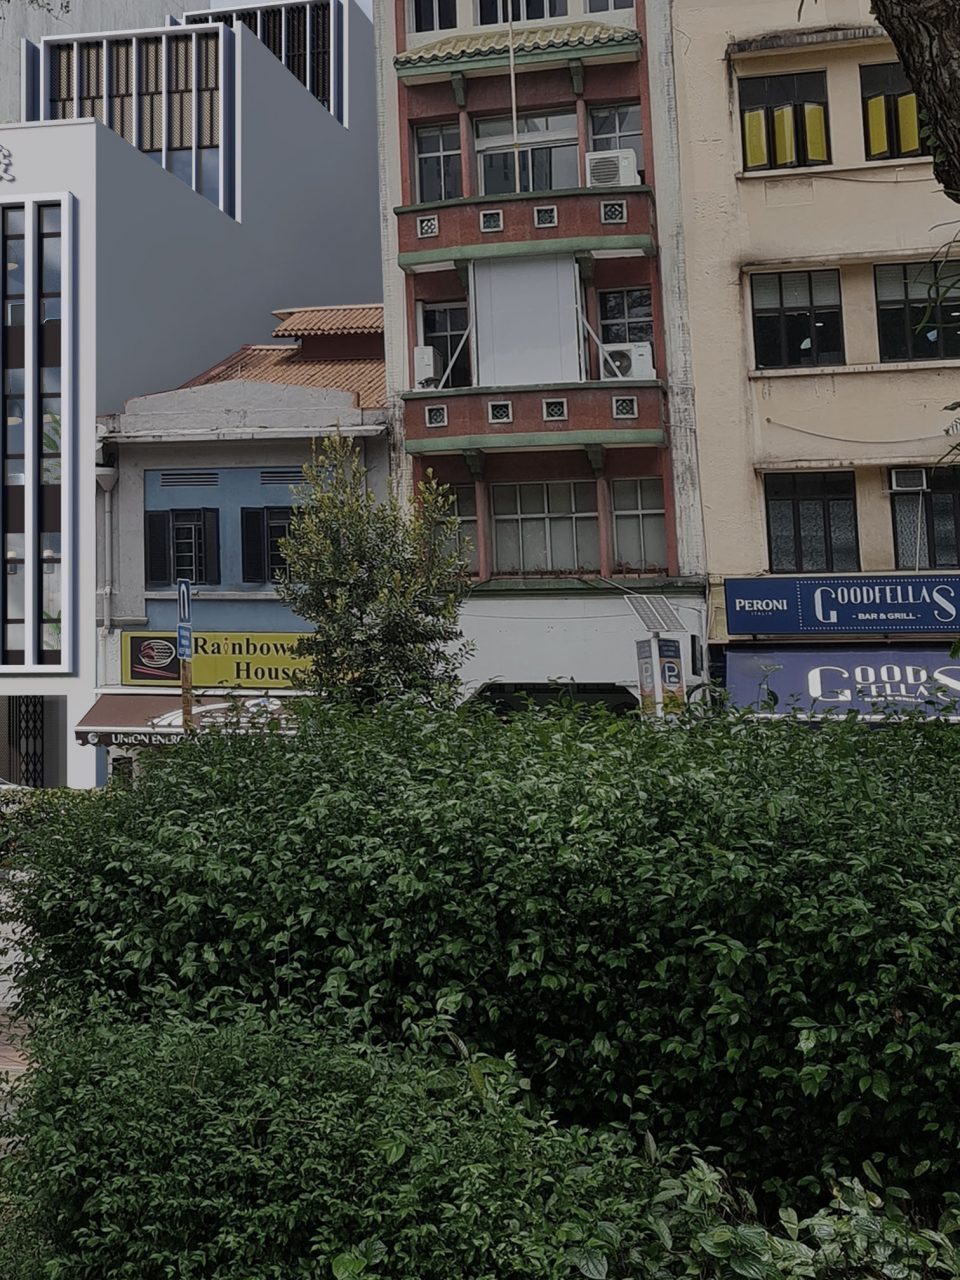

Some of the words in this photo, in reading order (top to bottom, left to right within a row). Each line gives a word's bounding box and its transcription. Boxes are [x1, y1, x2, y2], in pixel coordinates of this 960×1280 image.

[735, 598, 788, 611] PERONI
[814, 585, 957, 624] GOODFELLAS
[857, 612, 878, 620] BAR
[879, 612, 887, 620] &
[887, 612, 916, 620] GRILL
[112, 733, 149, 745] UNION
